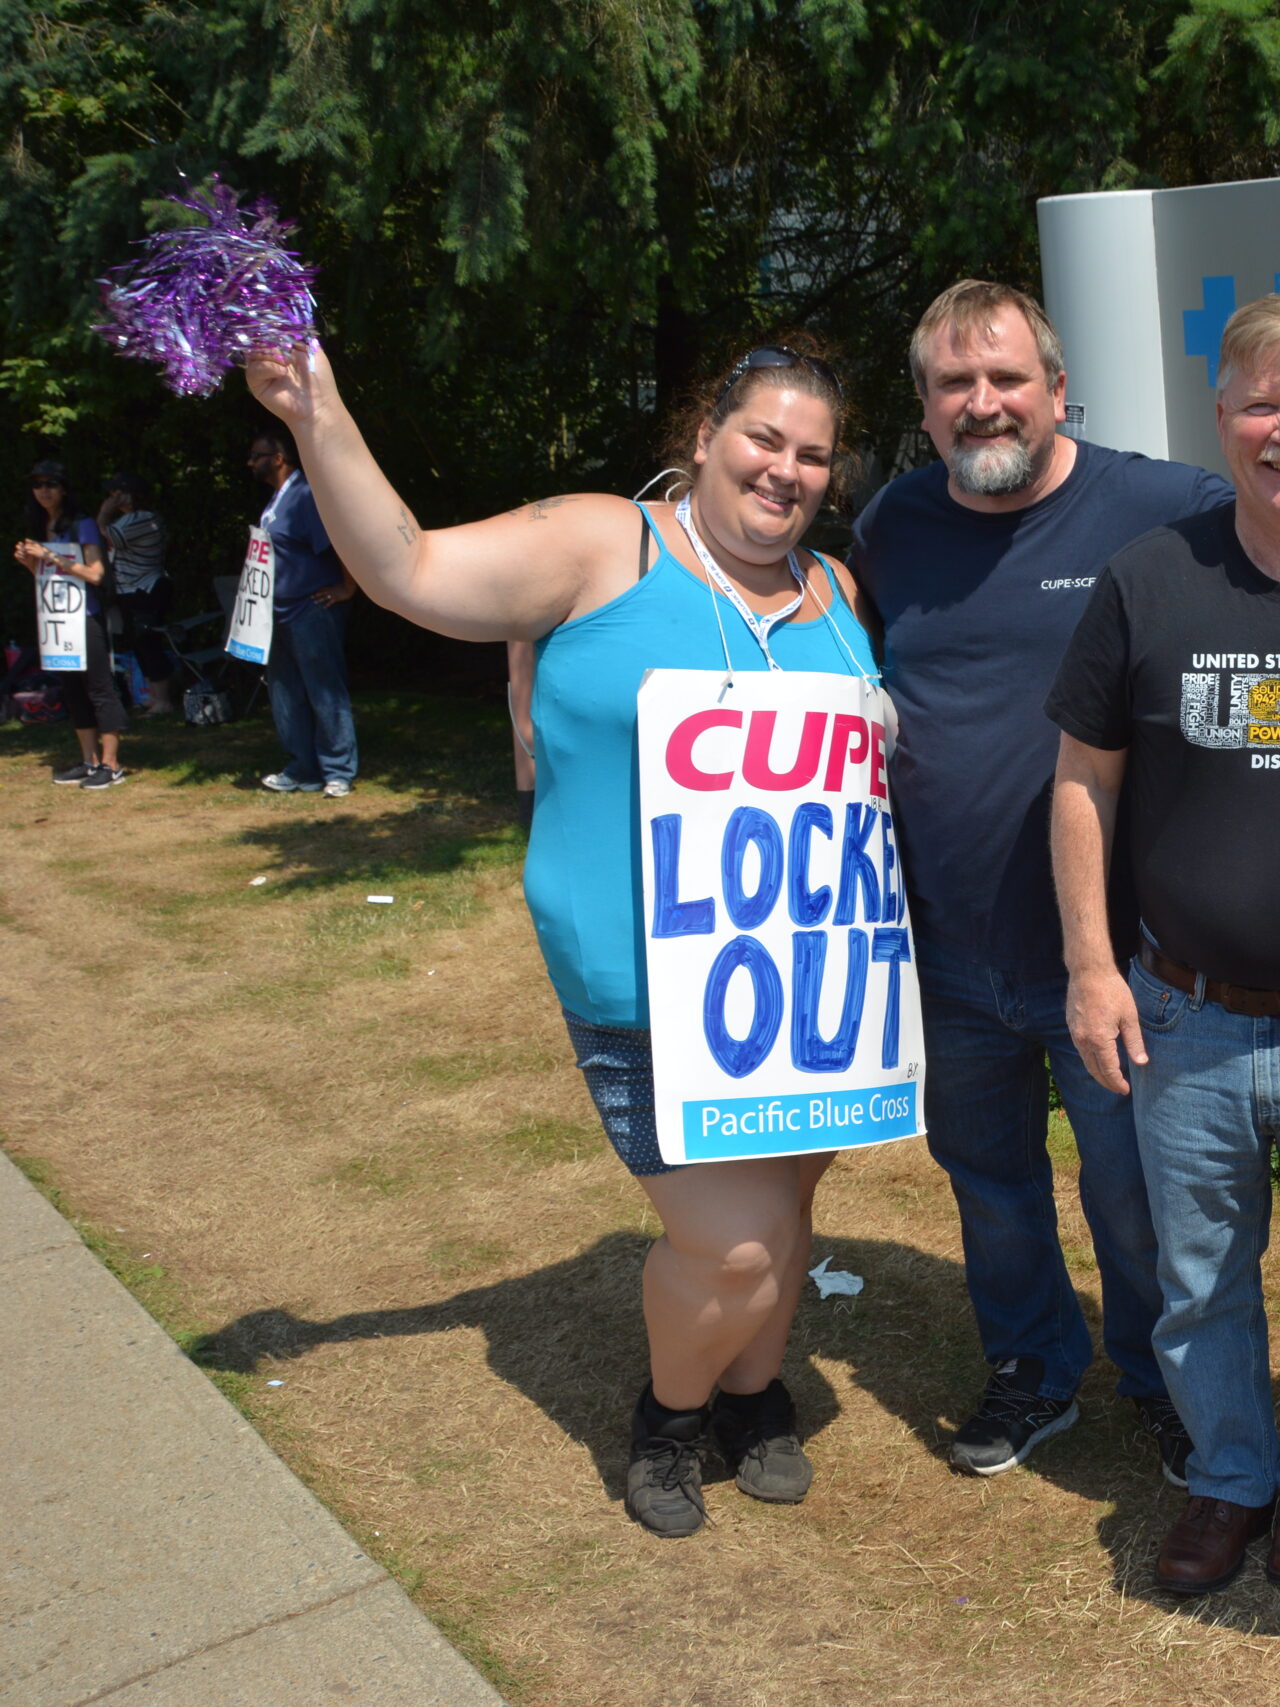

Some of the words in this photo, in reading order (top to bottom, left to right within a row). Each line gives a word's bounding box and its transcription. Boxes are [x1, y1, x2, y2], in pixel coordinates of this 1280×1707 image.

[1182, 673, 1215, 685] PRIDE
[1192, 653, 1260, 669] UNITED
[1230, 673, 1242, 710] UNITY
[1253, 693, 1276, 704] 1942
[1188, 702, 1201, 738] FIGHT
[1205, 728, 1241, 739] UNION
[664, 708, 888, 800] CUPE
[702, 926, 912, 1080] OUT
[701, 1100, 801, 1137] Pacific
[808, 1096, 864, 1130] Blue
[868, 1093, 909, 1123] Cross
